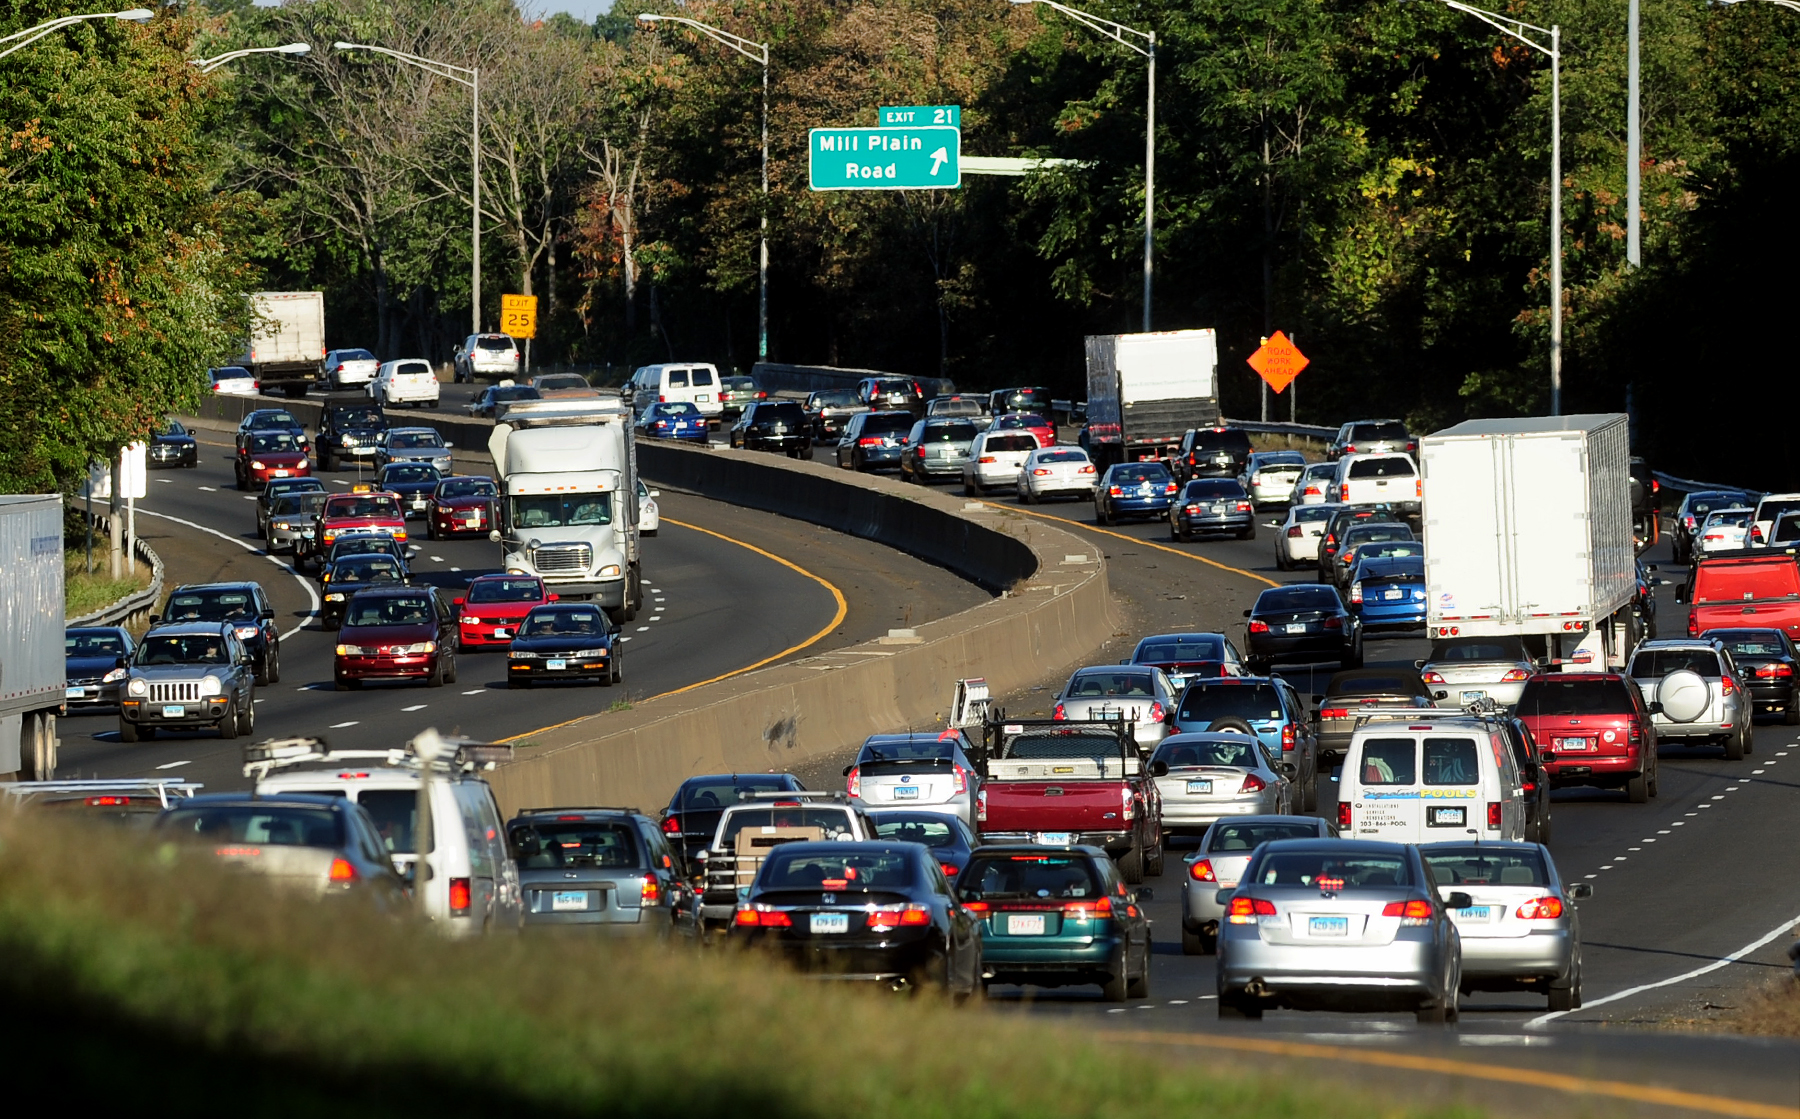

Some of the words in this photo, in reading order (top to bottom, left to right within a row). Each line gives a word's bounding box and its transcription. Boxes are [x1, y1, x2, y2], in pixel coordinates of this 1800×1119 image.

[886, 112, 915, 123] EXIT
[933, 109, 952, 124] 21
[820, 136, 858, 152] Mill
[868, 135, 922, 151] Plain
[846, 163, 896, 179] Road
[509, 314, 529, 326] 25
[1267, 347, 1292, 356] ROAD
[1266, 357, 1292, 365] WORK
[1362, 787, 1421, 800] Signature
[1420, 788, 1477, 799] POOLS
